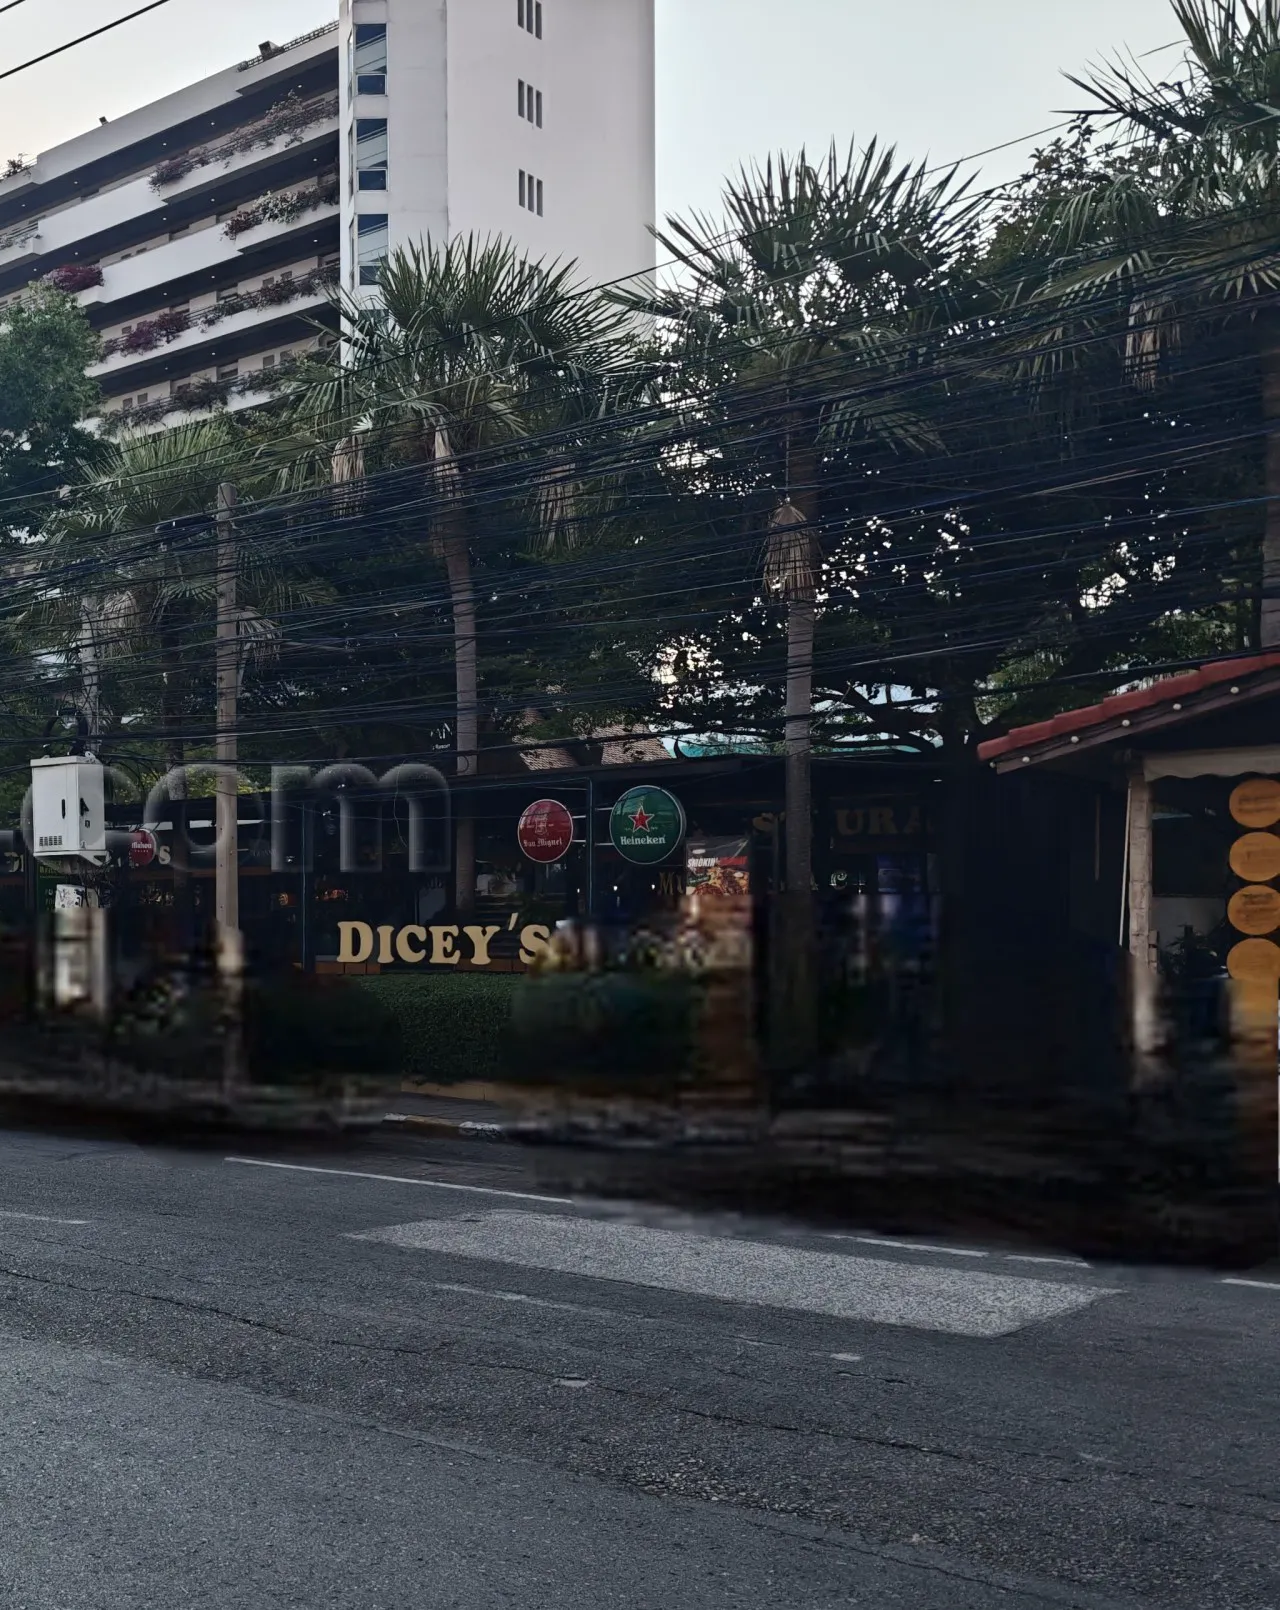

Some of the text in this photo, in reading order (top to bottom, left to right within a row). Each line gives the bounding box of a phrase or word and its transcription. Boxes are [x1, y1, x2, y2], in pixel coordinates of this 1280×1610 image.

[537, 837, 563, 848] Miguel
[620, 835, 666, 846] Heineken
[337, 913, 551, 965] DICEY'S
